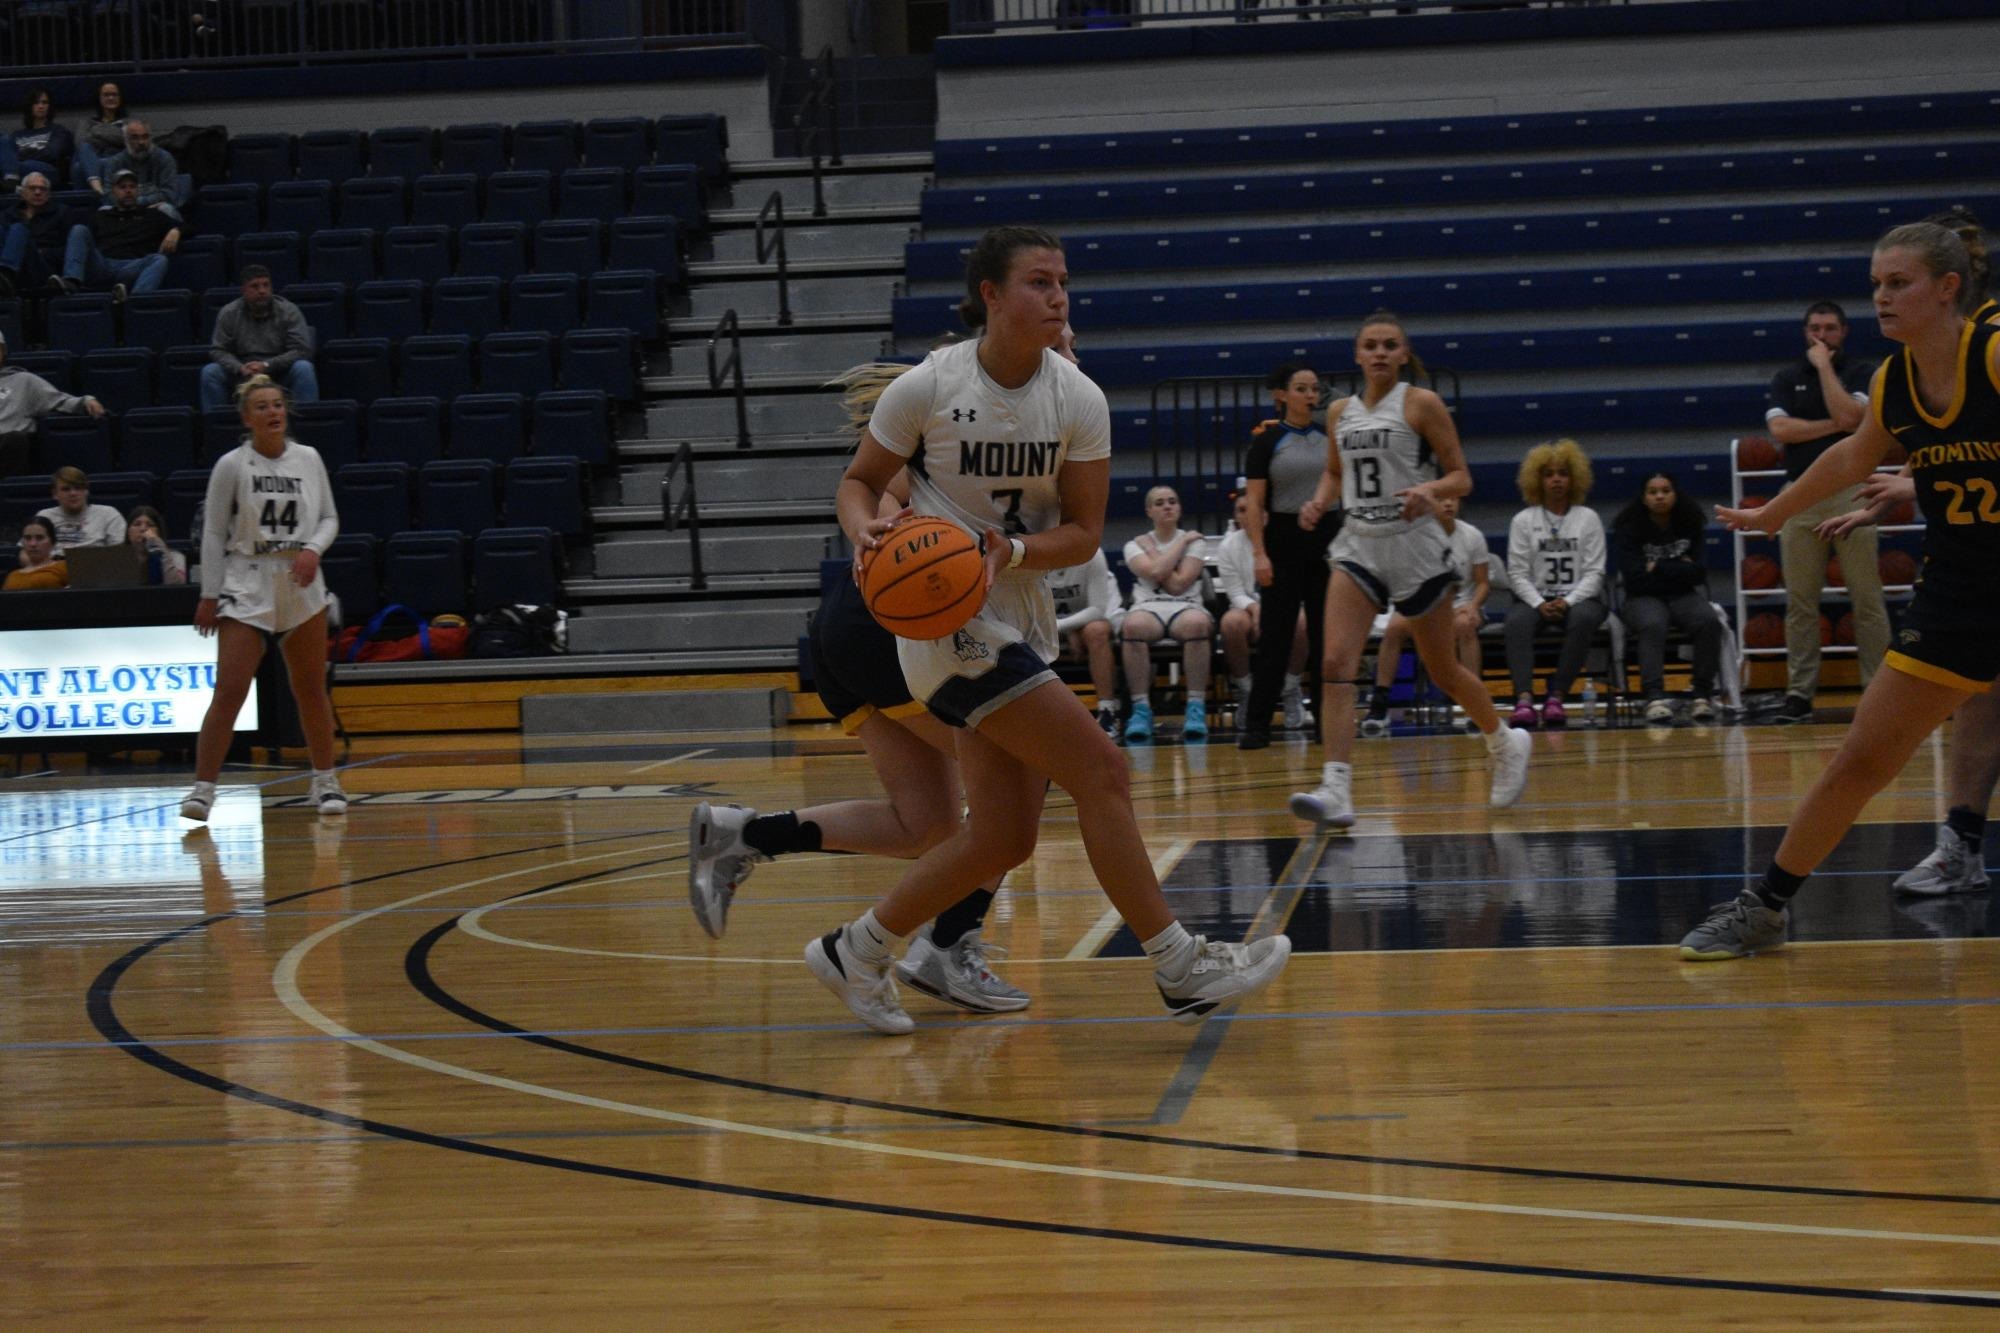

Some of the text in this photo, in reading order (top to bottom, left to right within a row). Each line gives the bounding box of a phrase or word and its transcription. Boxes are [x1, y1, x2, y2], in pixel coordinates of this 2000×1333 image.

[959, 440, 1061, 477] MOUNT
[252, 474, 303, 494] MOUNT
[1353, 456, 1382, 499] 13
[259, 499, 299, 535] 44
[1933, 477, 2000, 525] 22
[1544, 556, 1575, 585] 35
